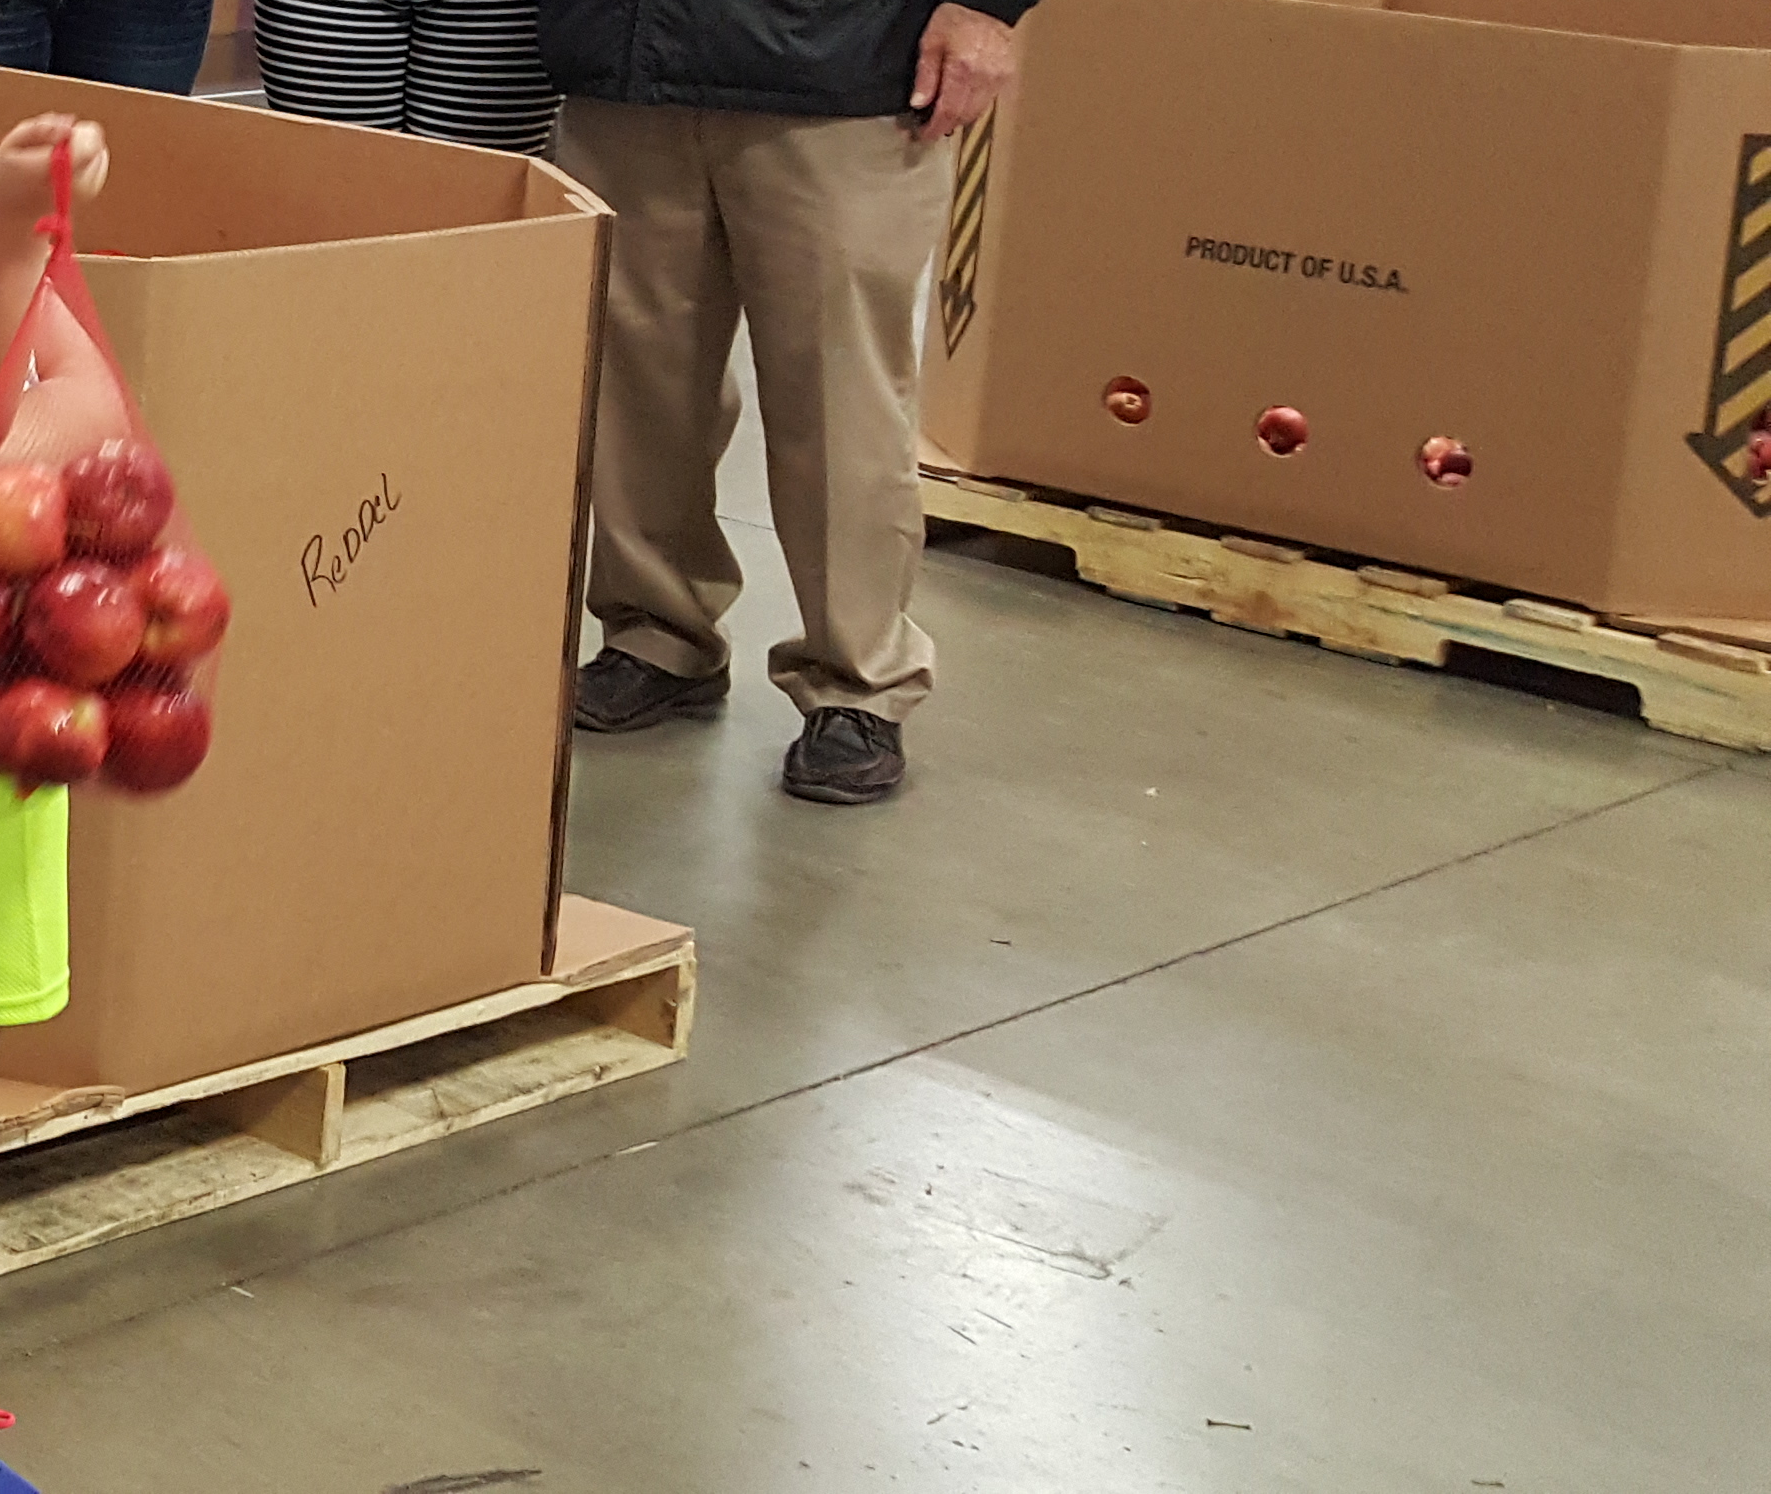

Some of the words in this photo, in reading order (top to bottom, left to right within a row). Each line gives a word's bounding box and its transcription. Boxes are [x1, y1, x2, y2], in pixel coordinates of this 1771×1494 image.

[1185, 234, 1297, 275] PRODUCT
[1300, 255, 1334, 279] OF
[1339, 260, 1409, 294] U.S.A.
